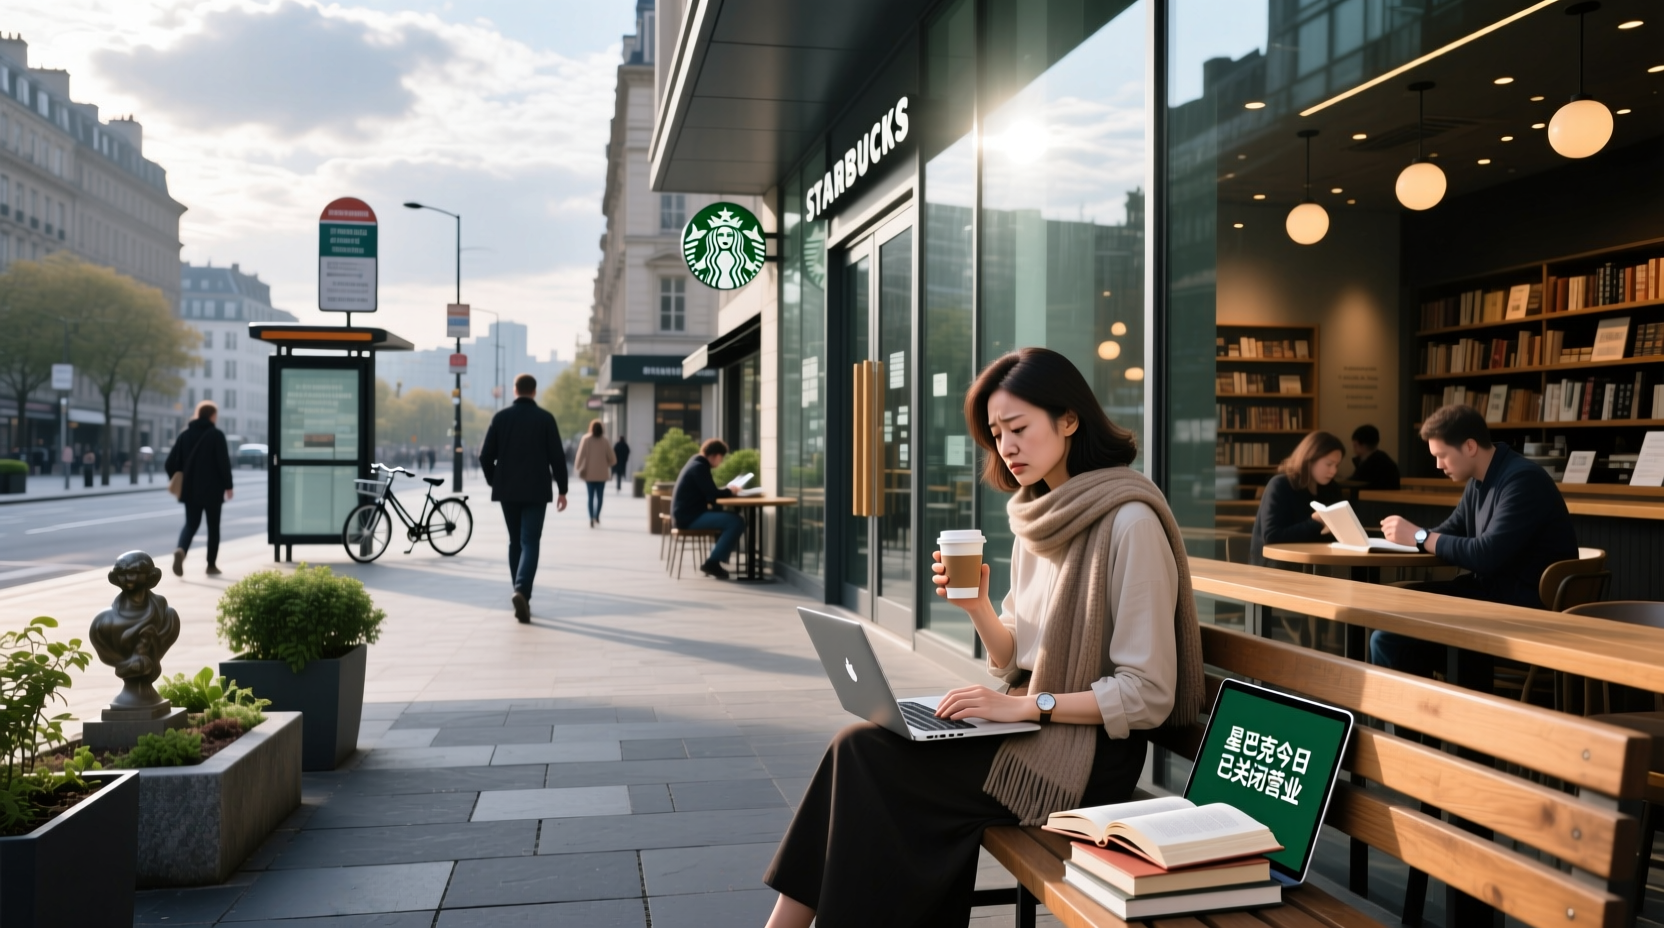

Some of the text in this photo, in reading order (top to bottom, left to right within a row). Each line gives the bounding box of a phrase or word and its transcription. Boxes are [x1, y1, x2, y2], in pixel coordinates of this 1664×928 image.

[805, 96, 909, 223] STARBUCKS
[1223, 725, 1312, 776] 星巴克今日
[1216, 752, 1303, 806] 已关闭营业
